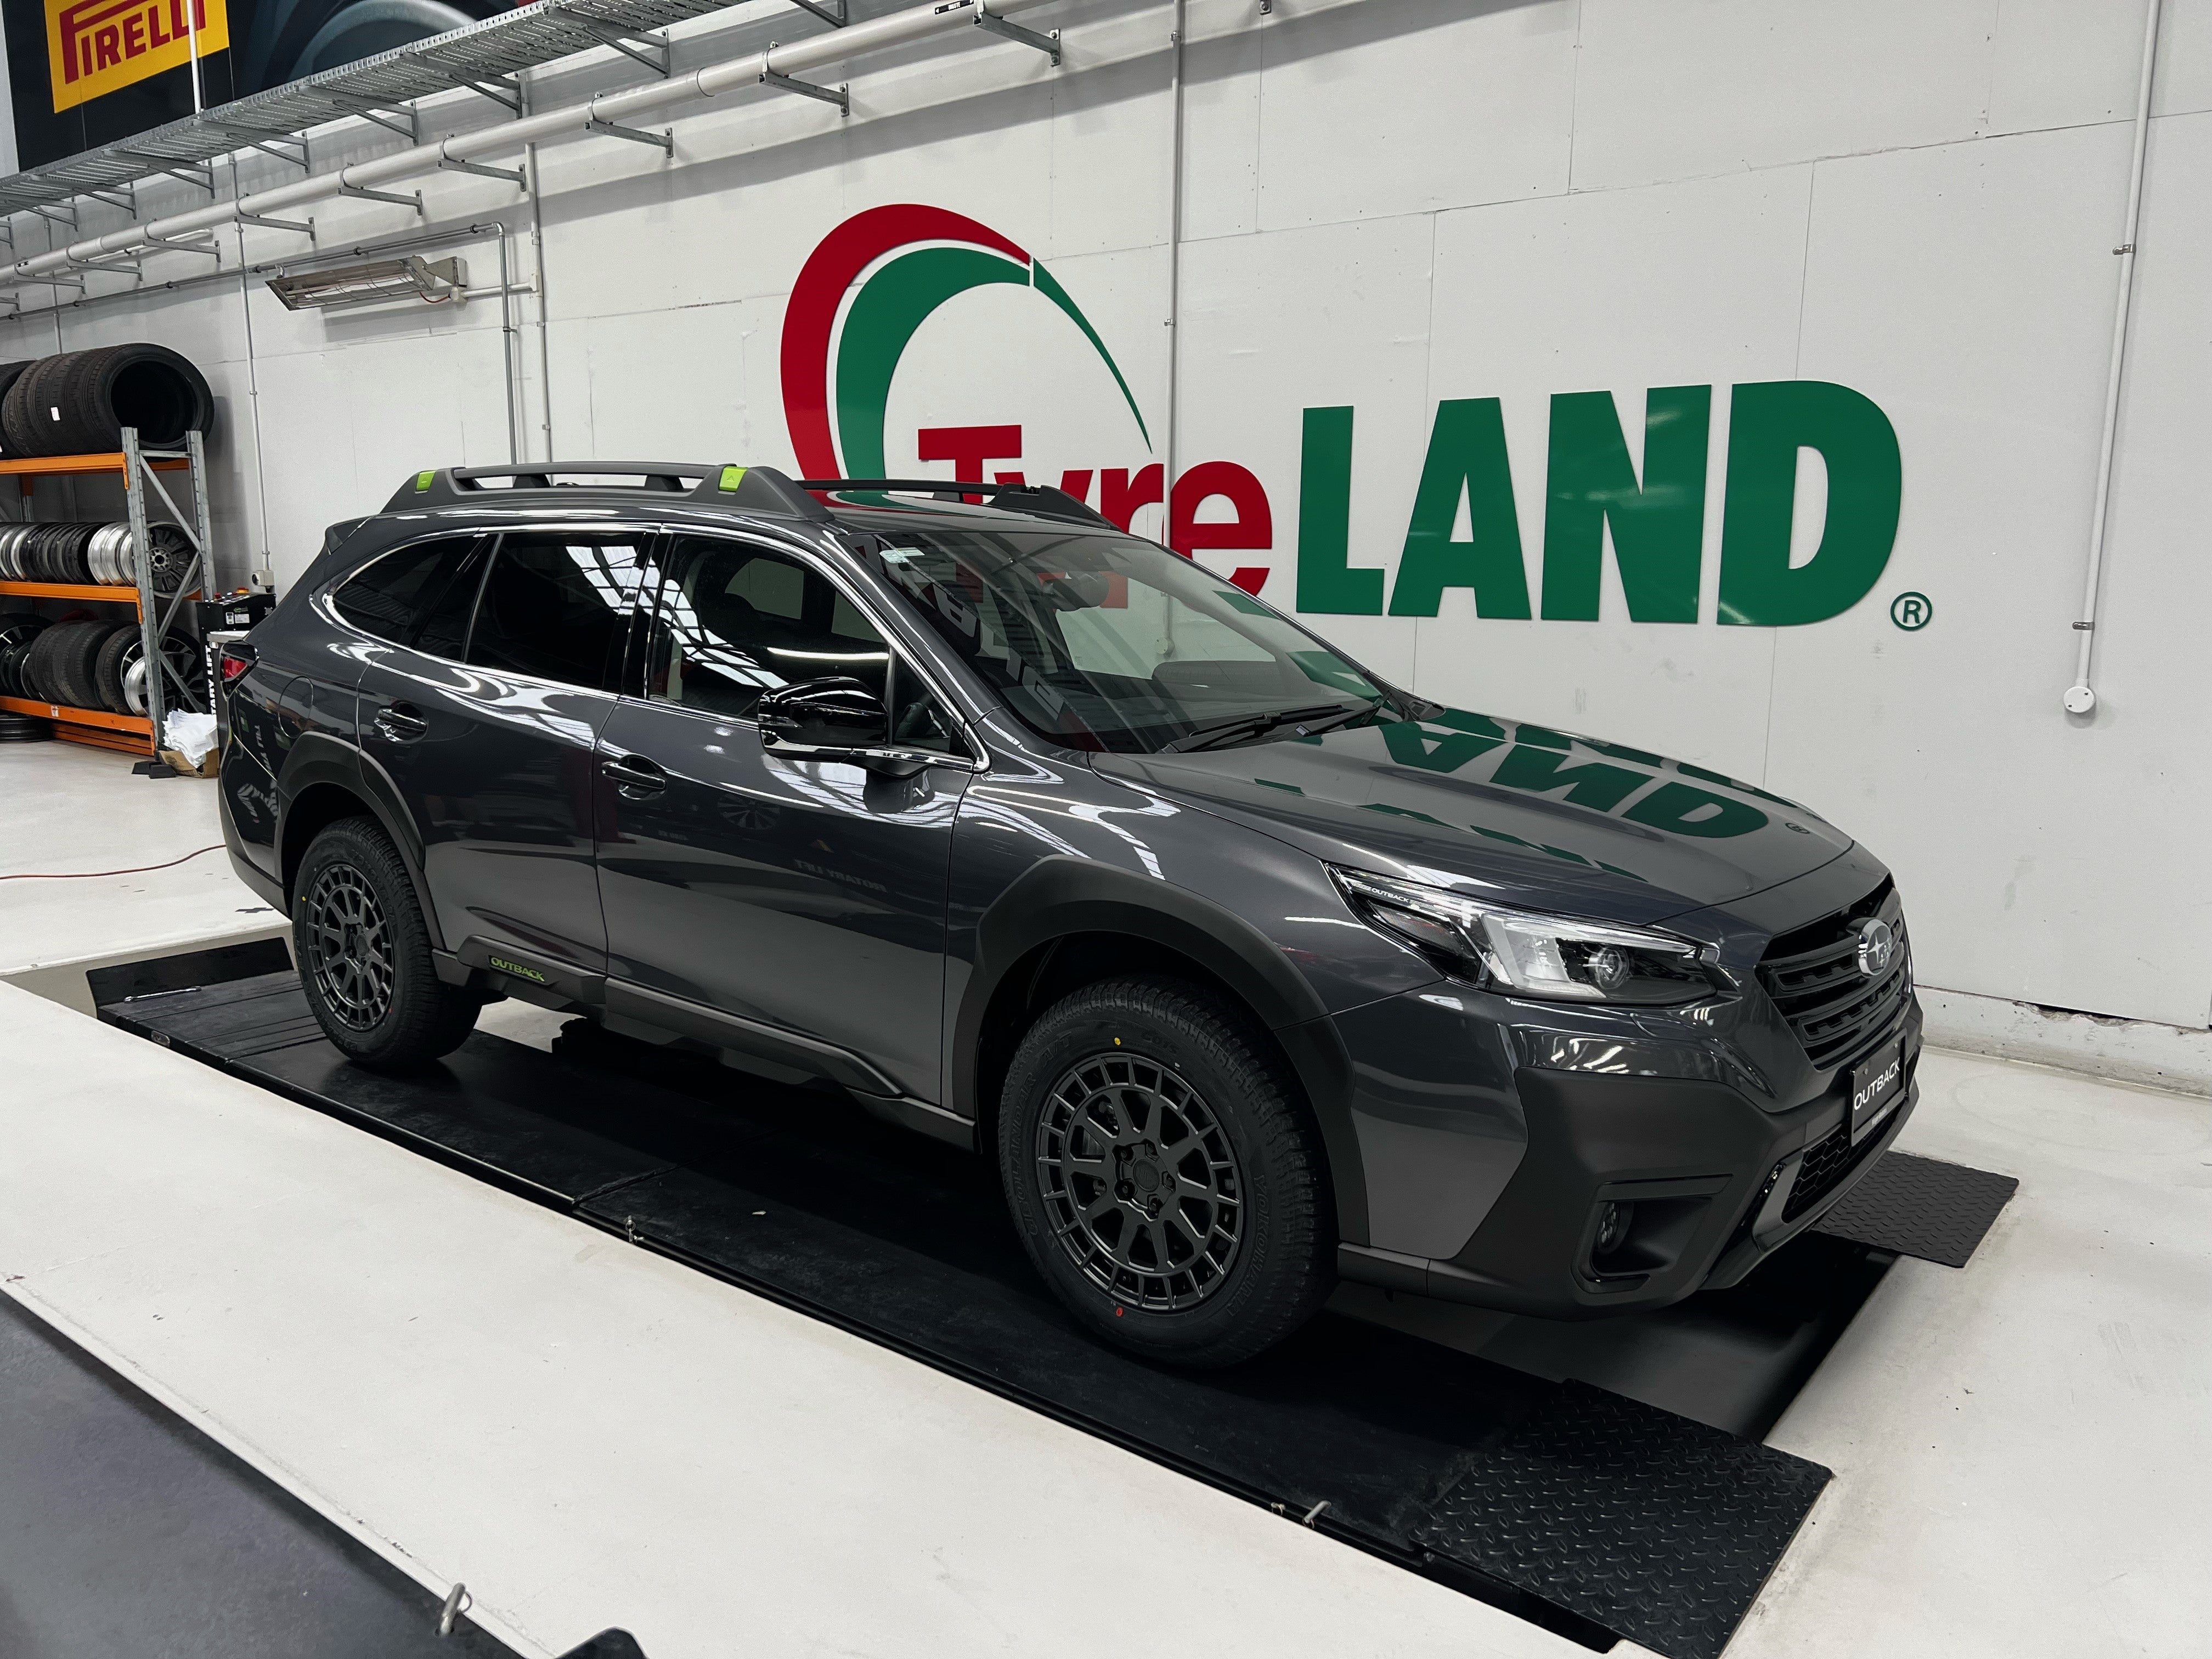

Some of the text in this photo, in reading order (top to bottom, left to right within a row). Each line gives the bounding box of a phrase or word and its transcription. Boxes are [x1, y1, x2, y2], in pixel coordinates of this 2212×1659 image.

[1371, 888, 1409, 903] OUTBACK
[491, 957, 545, 981] OUTBACK
[1854, 1057, 1900, 1111] OUTBACK
[1226, 1175, 1270, 1316] YOKOHAMA
